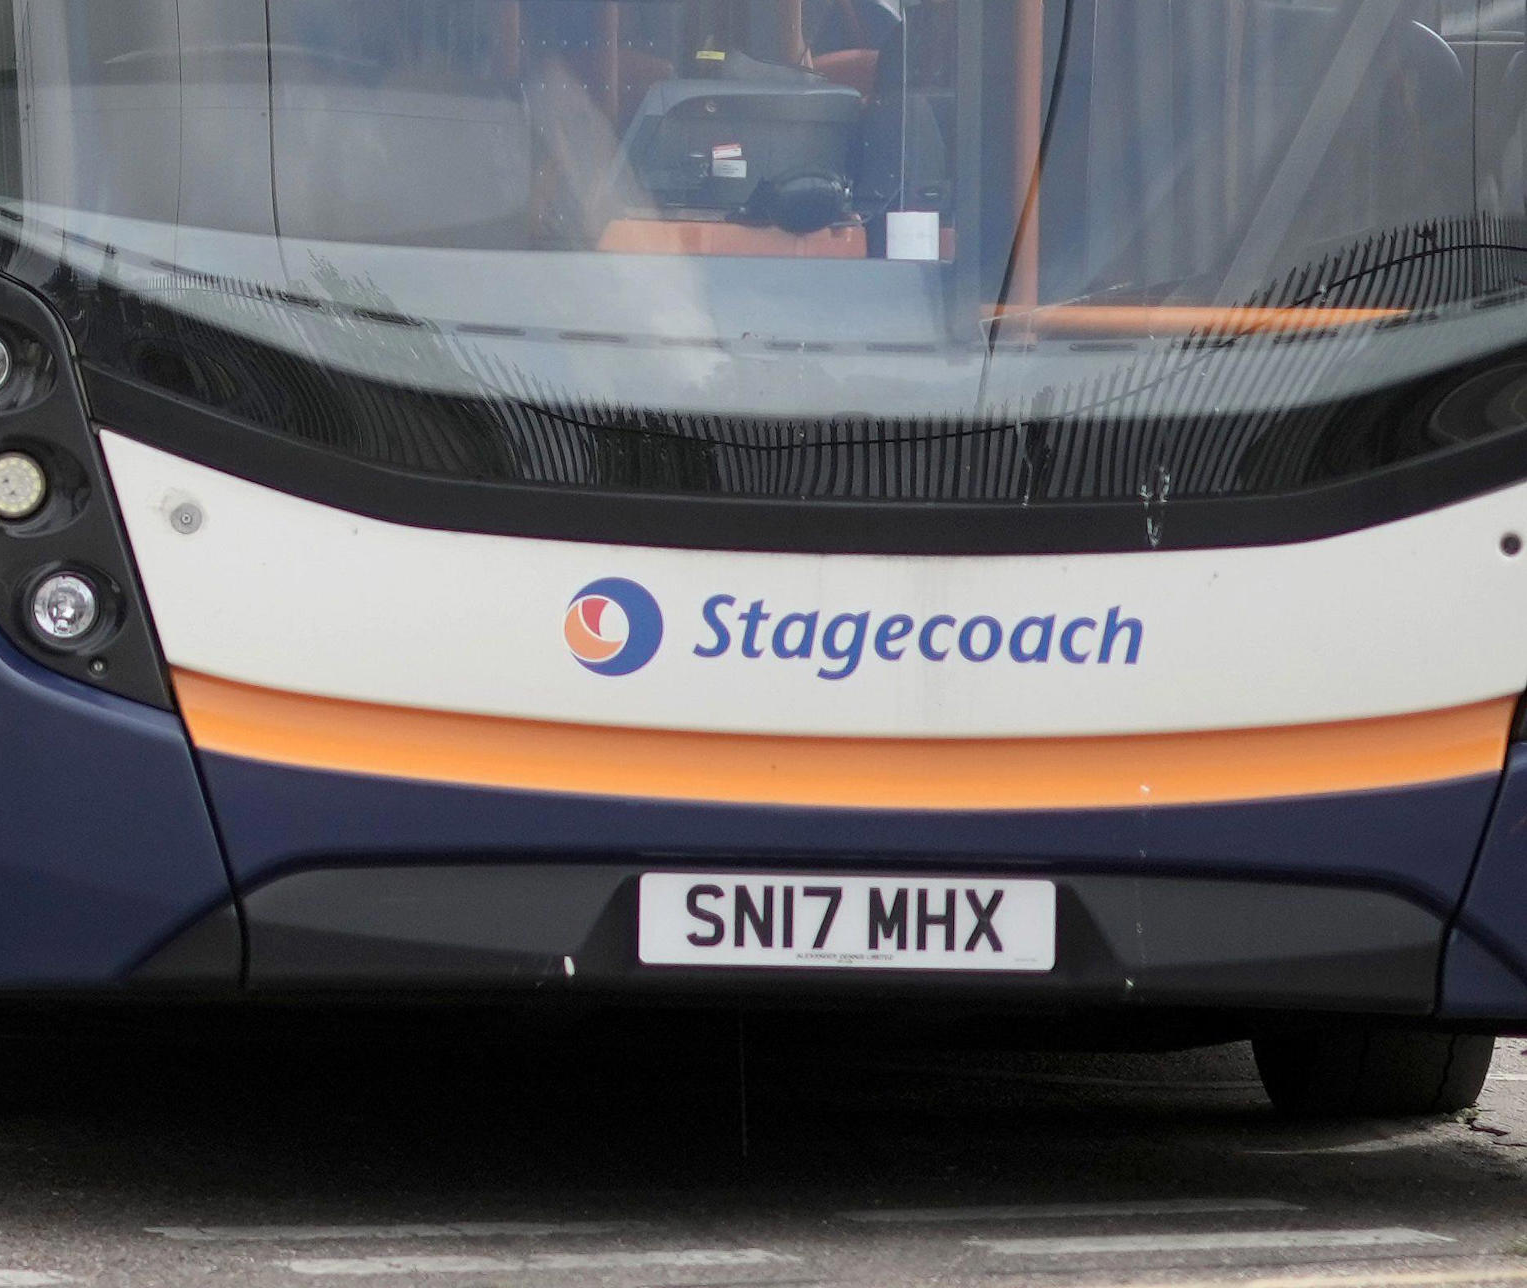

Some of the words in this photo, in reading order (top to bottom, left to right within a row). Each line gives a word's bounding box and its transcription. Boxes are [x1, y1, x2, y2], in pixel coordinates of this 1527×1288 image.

[693, 594, 1144, 680] Stagecoach
[686, 883, 843, 950] SN17
[868, 887, 1005, 953] MHX
